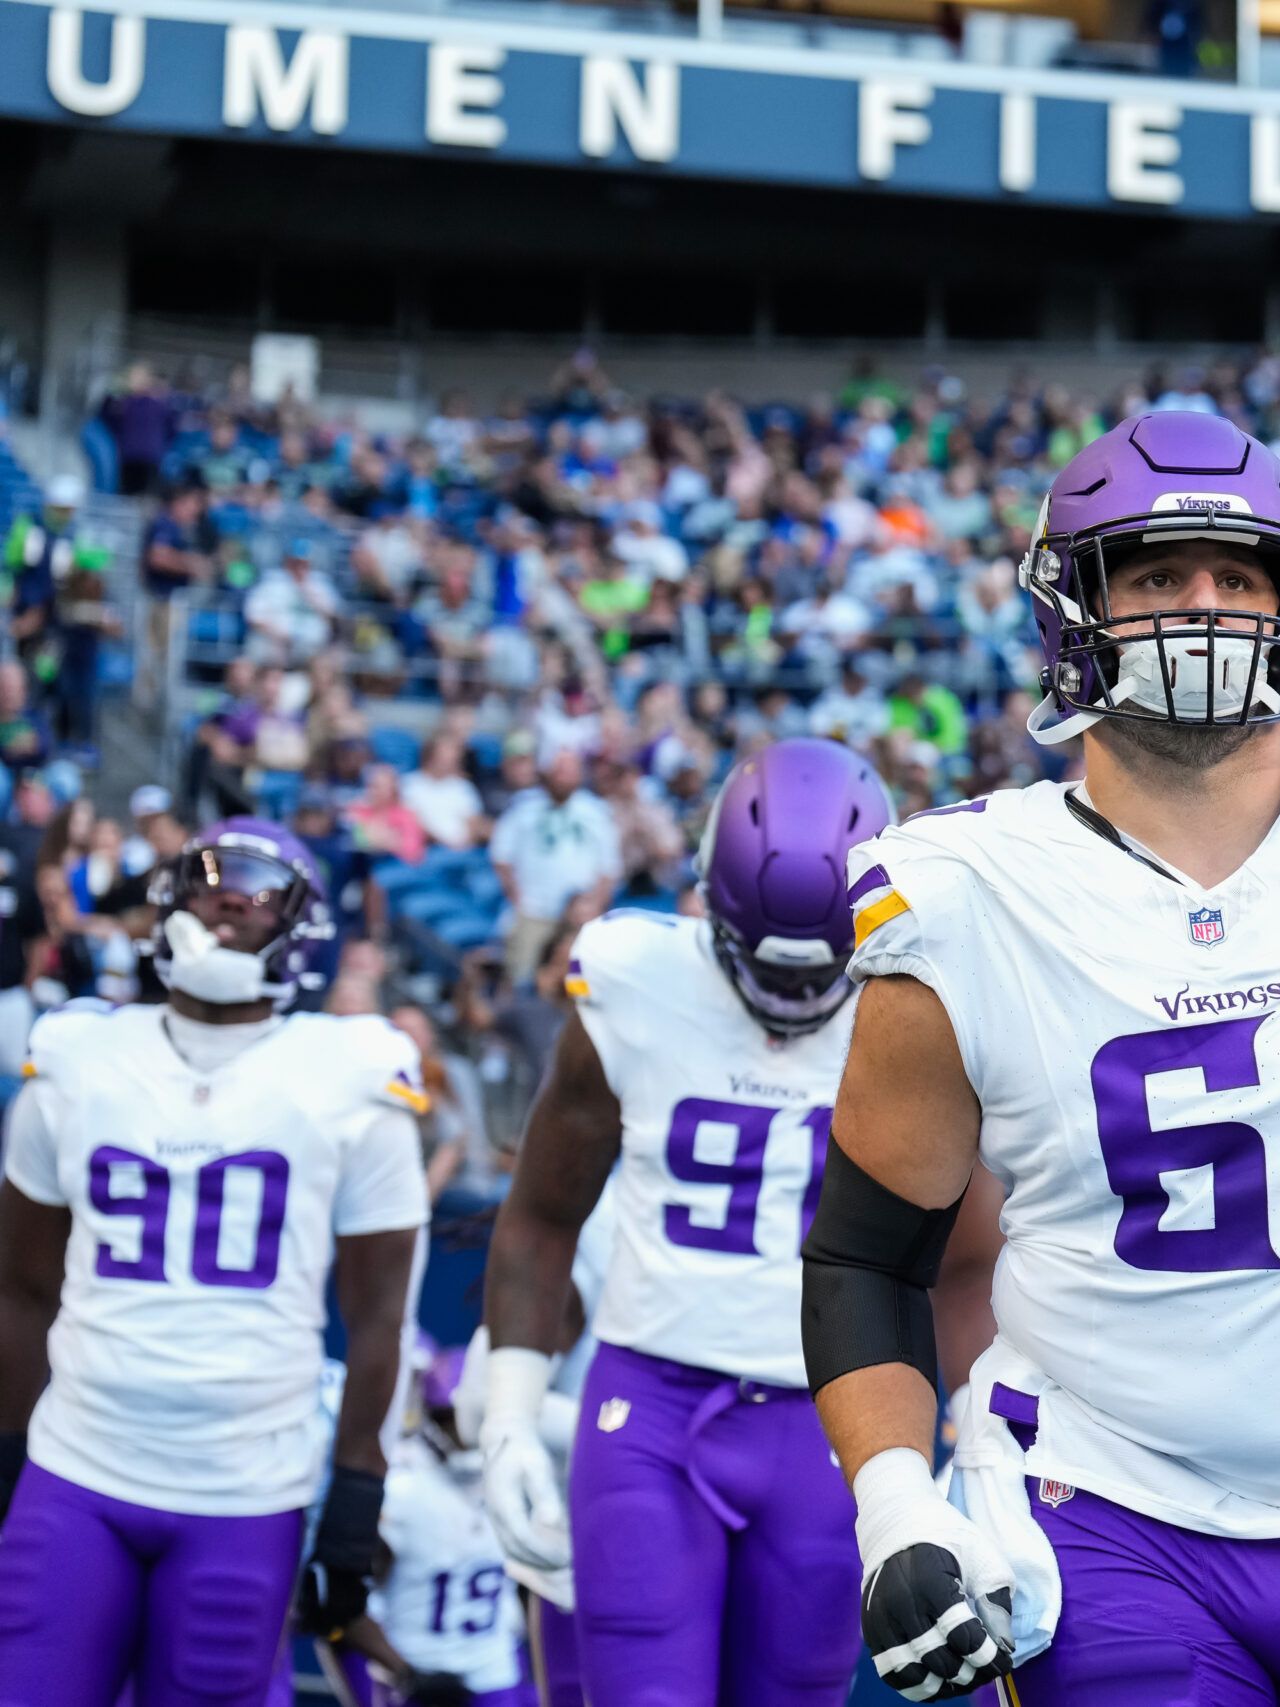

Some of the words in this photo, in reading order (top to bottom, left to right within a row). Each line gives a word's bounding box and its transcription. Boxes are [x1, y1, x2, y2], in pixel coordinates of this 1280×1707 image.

[46, 5, 682, 163] UMEN
[1193, 922, 1222, 941] NFL
[89, 1145, 289, 1289] 90
[661, 1097, 835, 1258] 91
[1045, 1480, 1071, 1498] NFL
[431, 1565, 505, 1635] 19
